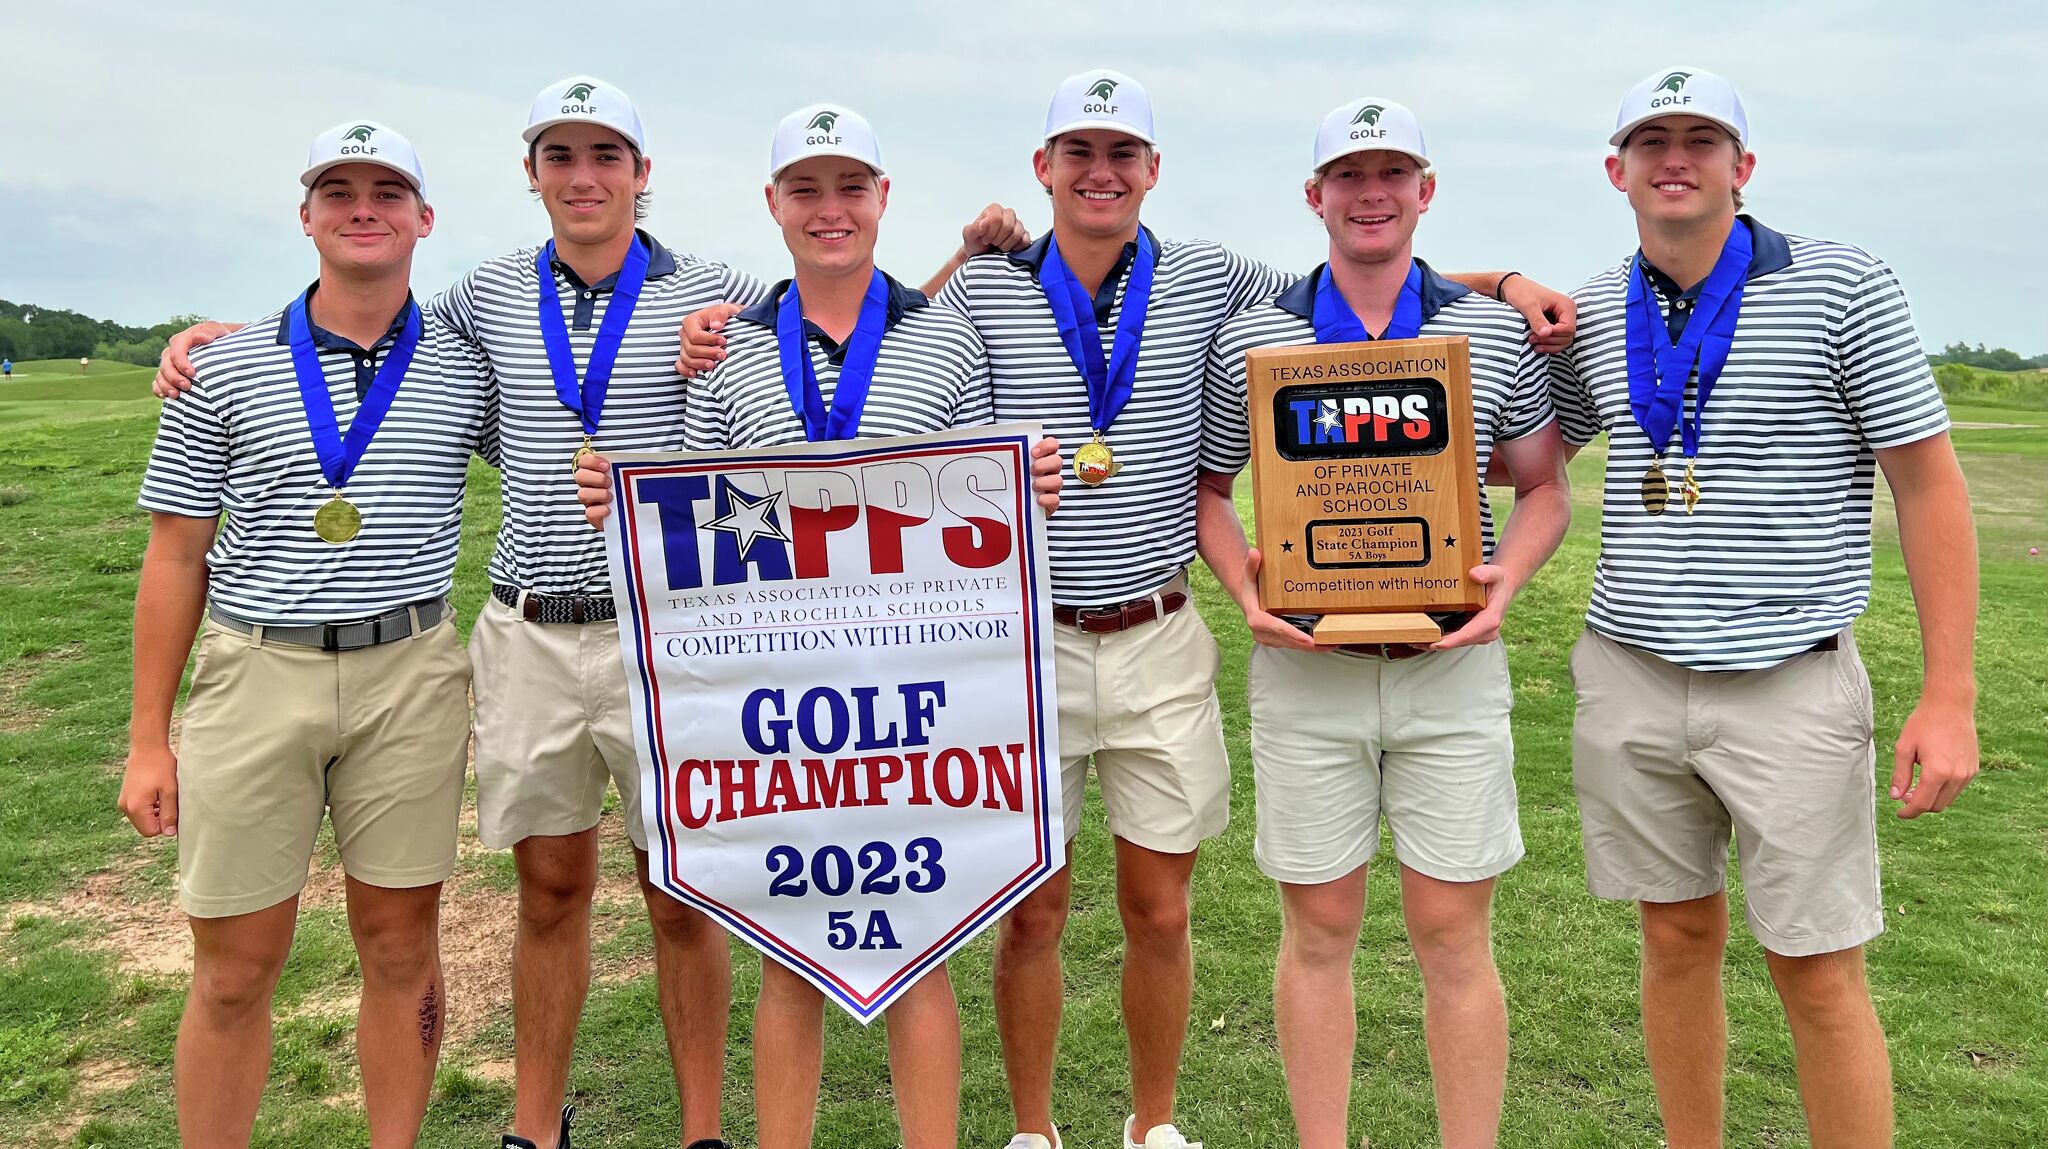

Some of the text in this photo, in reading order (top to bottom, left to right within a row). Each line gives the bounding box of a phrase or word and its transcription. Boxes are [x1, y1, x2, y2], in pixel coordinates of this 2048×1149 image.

[561, 104, 597, 115] GOLF
[1083, 103, 1119, 115] GOLF
[1651, 95, 1692, 108] GOLF
[806, 134, 843, 146] GOLF
[1350, 128, 1387, 140] GOLF
[340, 145, 378, 156] GOLF
[1270, 357, 1446, 381] TEXAS ASSOCIATION
[1289, 394, 1431, 445] TAPPS
[1314, 462, 1412, 479] OF PRIVATE
[1296, 479, 1434, 497] AND PAROCHIAL
[1323, 498, 1408, 513] SCHOOLS
[636, 455, 1013, 591] TAPPS
[1338, 526, 1394, 538] 2023 Golf
[1316, 538, 1418, 553] State Champion
[1349, 551, 1387, 562] 5A Boys
[668, 577, 1008, 610] TEXAS ASSOCIATION OF PRIVATE
[1284, 576, 1459, 594] Competition with Honor
[696, 598, 985, 628] AND PAROCHIAL SCHOOLS
[666, 619, 1010, 659] COMPETITION WITH HONOR
[741, 680, 947, 755] GOLF
[674, 743, 1025, 830] CHAMPION
[765, 836, 946, 898] 2023
[827, 910, 902, 951] 5A
